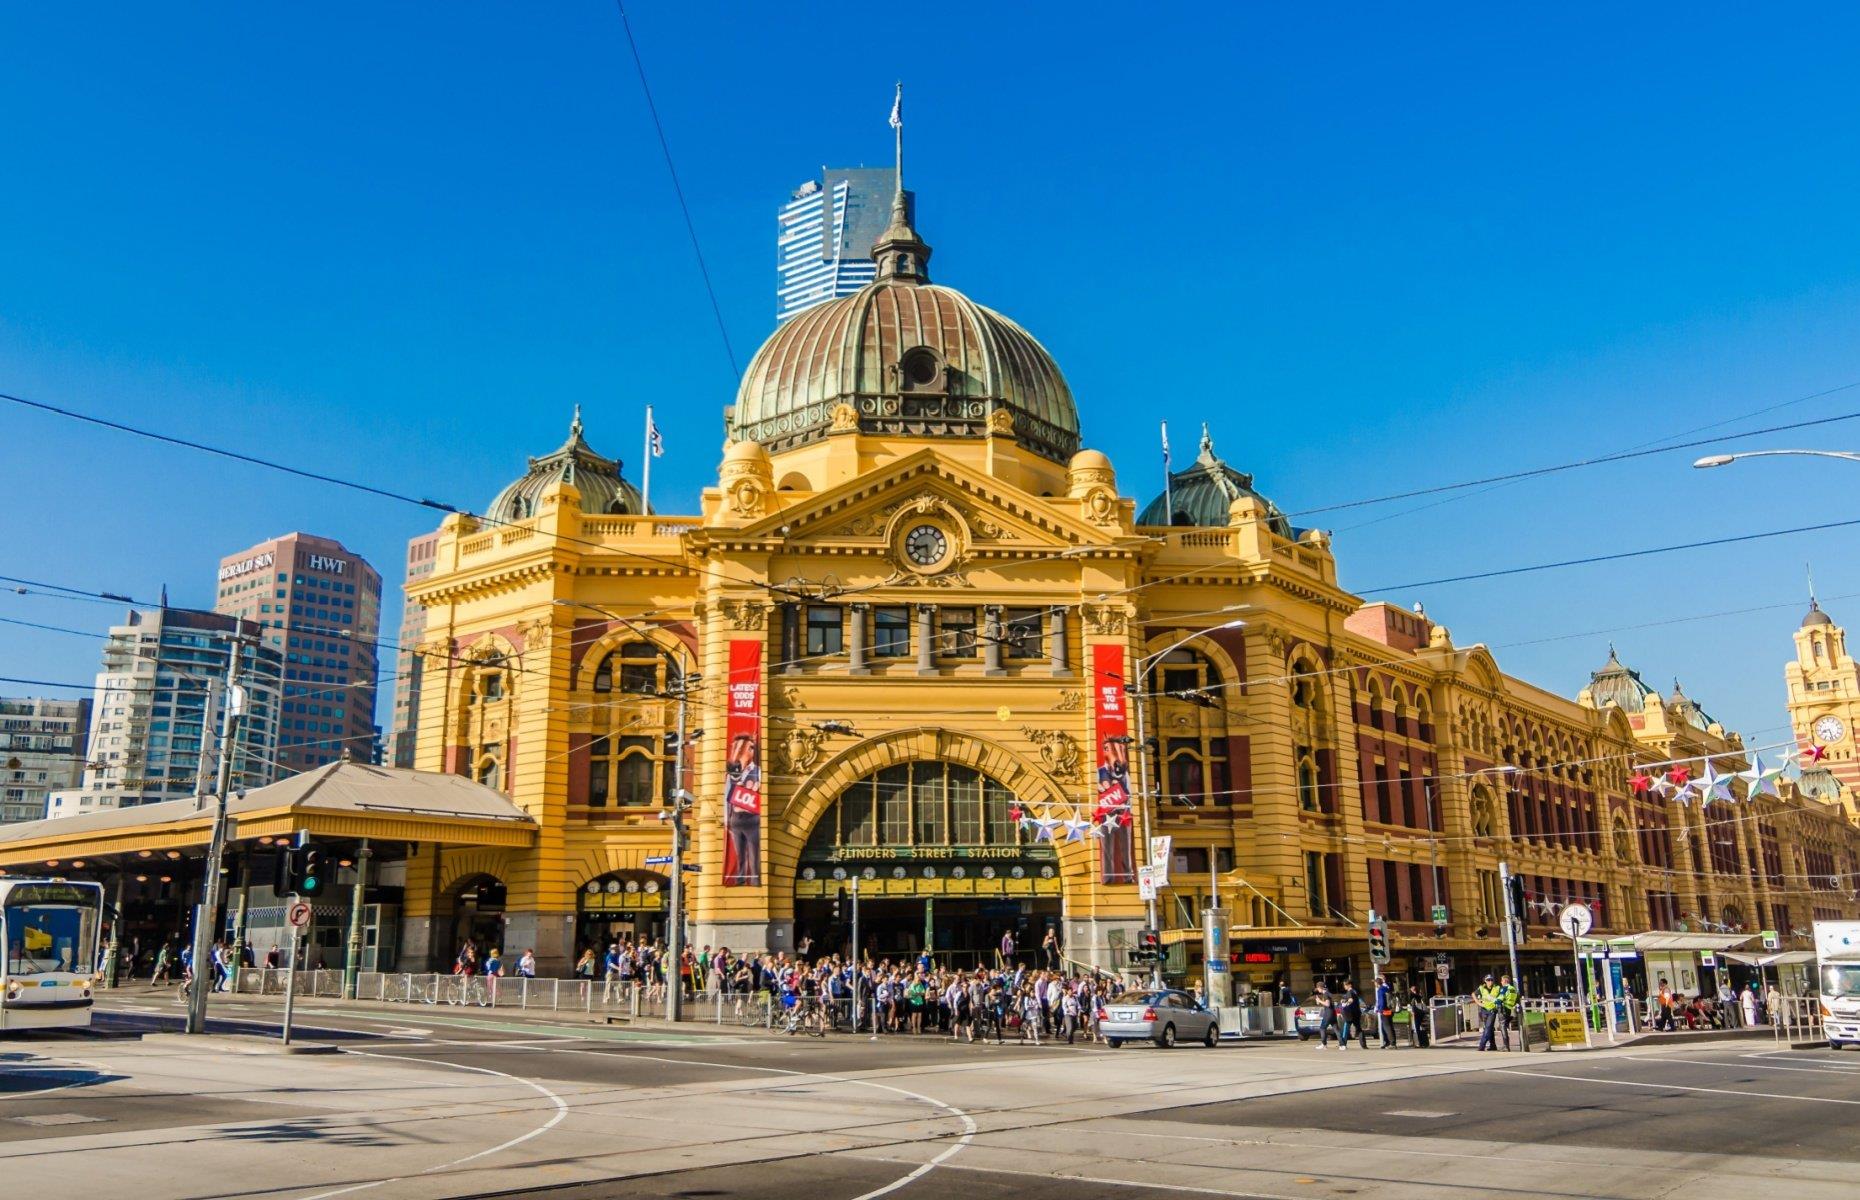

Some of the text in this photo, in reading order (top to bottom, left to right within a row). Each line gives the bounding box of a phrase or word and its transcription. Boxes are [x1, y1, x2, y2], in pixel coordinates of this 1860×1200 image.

[218, 552, 273, 578] HERALD SUN
[310, 554, 346, 573] HWT
[730, 683, 759, 692] LATEST
[733, 691, 755, 700] ODDS
[1105, 694, 1116, 703] TO
[1102, 703, 1119, 711] WIN
[735, 790, 757, 808] LOL
[839, 847, 1021, 859] FLINDERS STREET STATION
